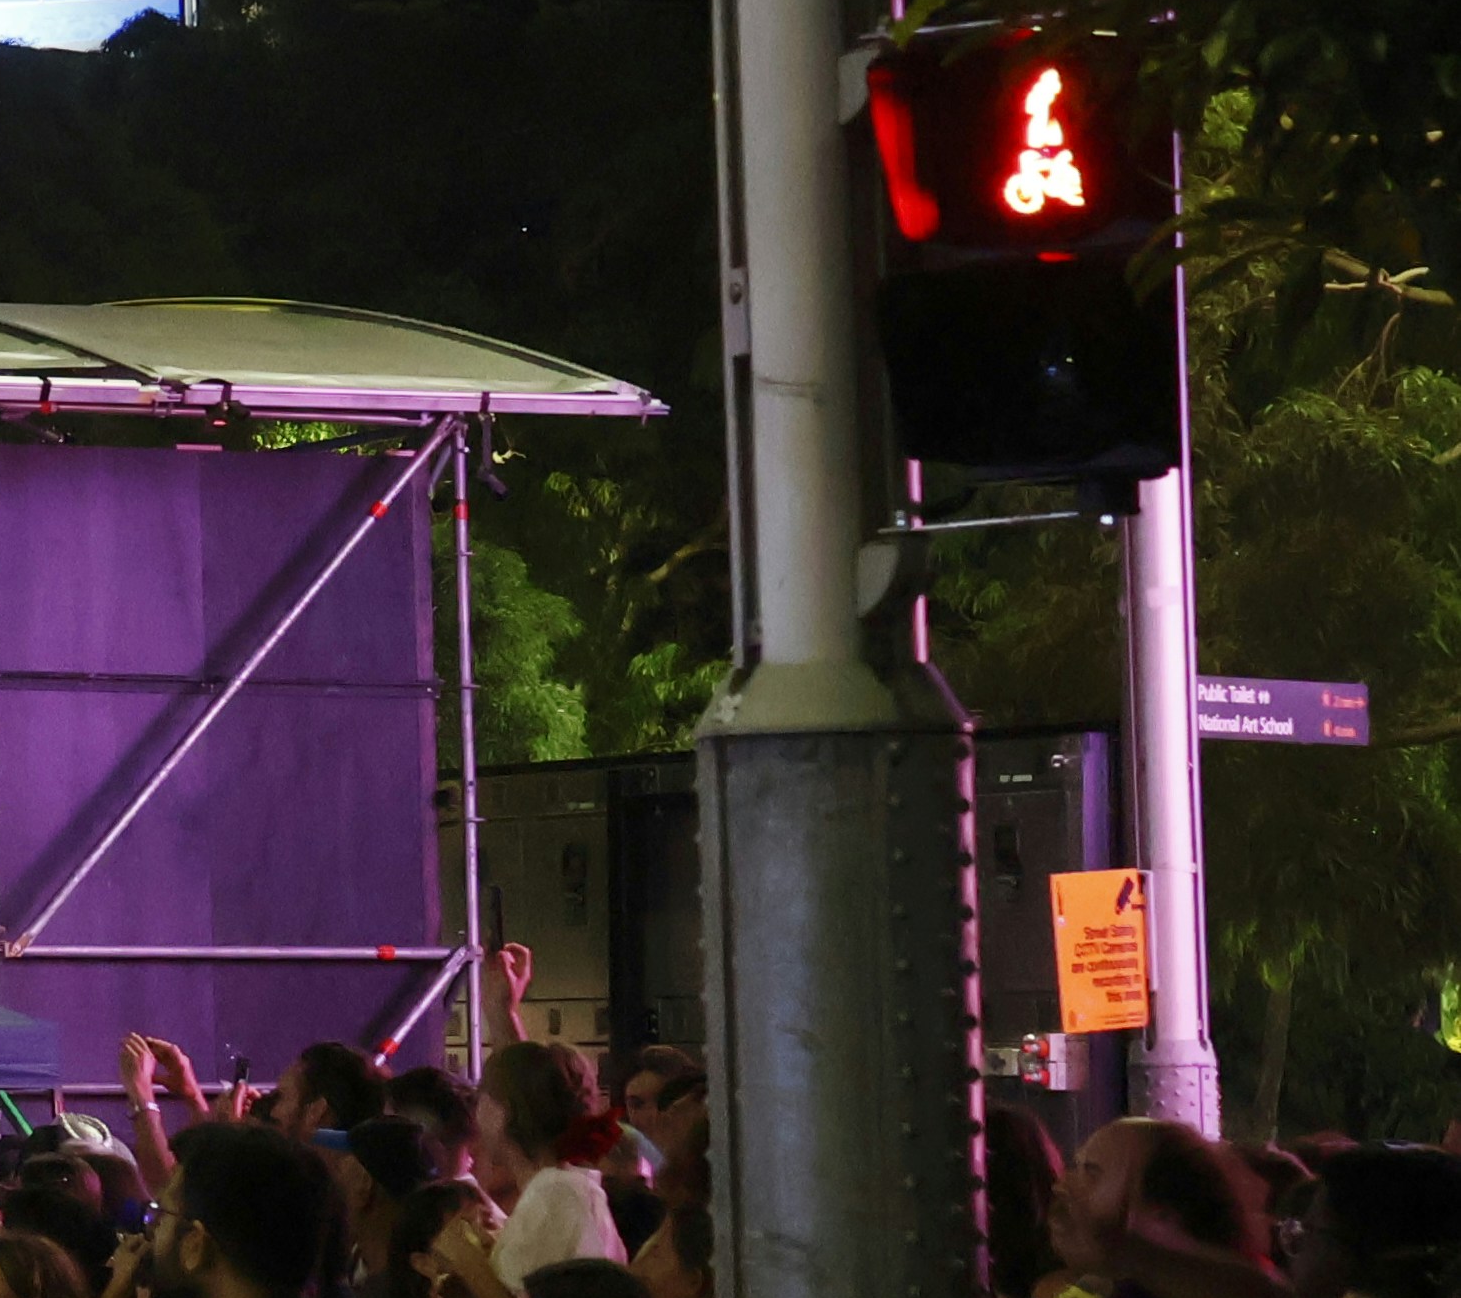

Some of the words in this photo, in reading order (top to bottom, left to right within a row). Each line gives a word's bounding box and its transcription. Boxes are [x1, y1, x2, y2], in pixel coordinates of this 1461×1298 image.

[1198, 684, 1228, 702] Public
[1198, 714, 1240, 733] National
[1242, 715, 1259, 734] Art
[1260, 717, 1295, 736] School
